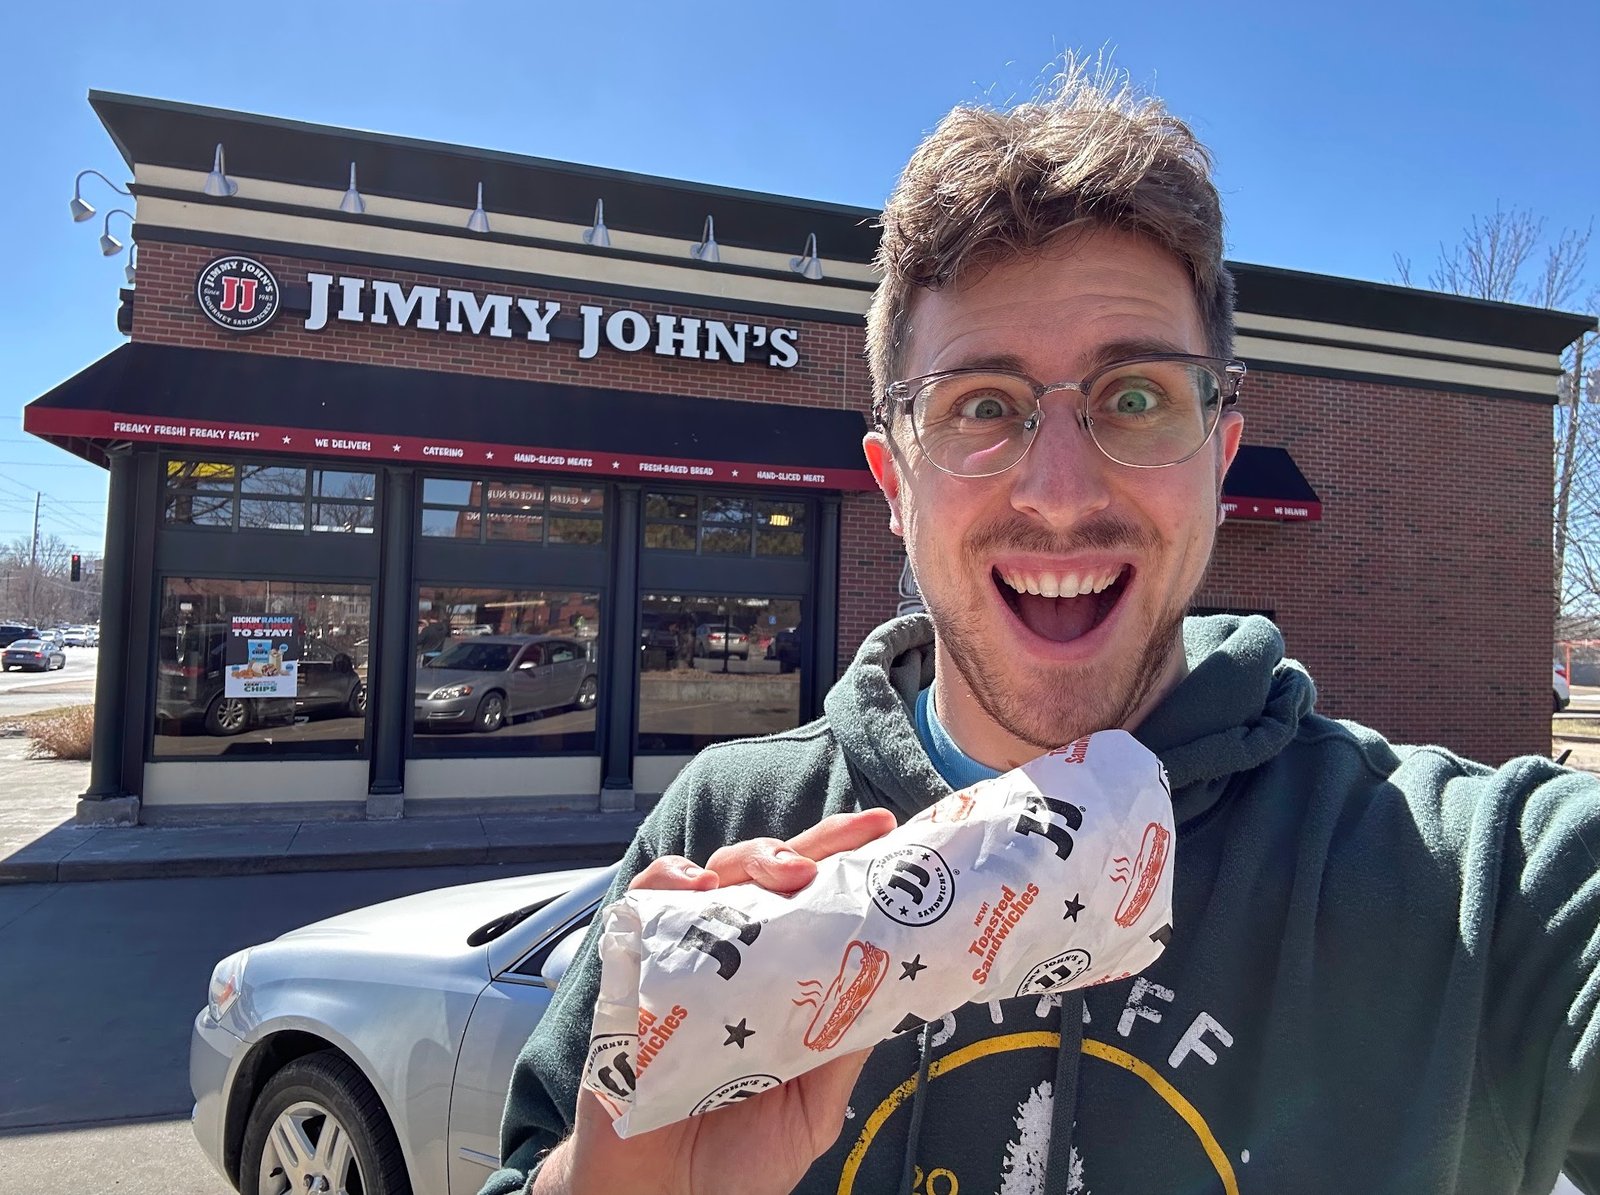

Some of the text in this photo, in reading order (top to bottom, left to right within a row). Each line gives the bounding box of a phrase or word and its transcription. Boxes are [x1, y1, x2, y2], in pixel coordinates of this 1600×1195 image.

[204, 261, 274, 293] JIMMY JOHN'S
[220, 276, 258, 313] JJ
[204, 295, 273, 326] GOURMET SANDWICHES
[304, 272, 799, 368] JIMMY JOHN'S
[113, 422, 151, 434] FREAKY
[154, 425, 187, 437] FRESH!
[189, 428, 227, 439] FREAKY
[315, 438, 371, 451] WE DELIVER!
[422, 446, 464, 458] CATERING
[514, 453, 593, 467] HAND-SLICED MEATS
[639, 463, 714, 476] FRESH-BAKED BREAD
[757, 470, 825, 483] HAND-SLICED MEATS
[1274, 506, 1308, 517] WE DELIVER!
[232, 629, 293, 637] TO STAY!
[873, 872, 895, 907] JIM
[888, 860, 931, 906] JJ
[917, 866, 947, 918] SANDWICHES
[968, 884, 1017, 958] Toasted
[973, 901, 990, 927] NEW!
[972, 882, 1040, 985] Sandwiches
